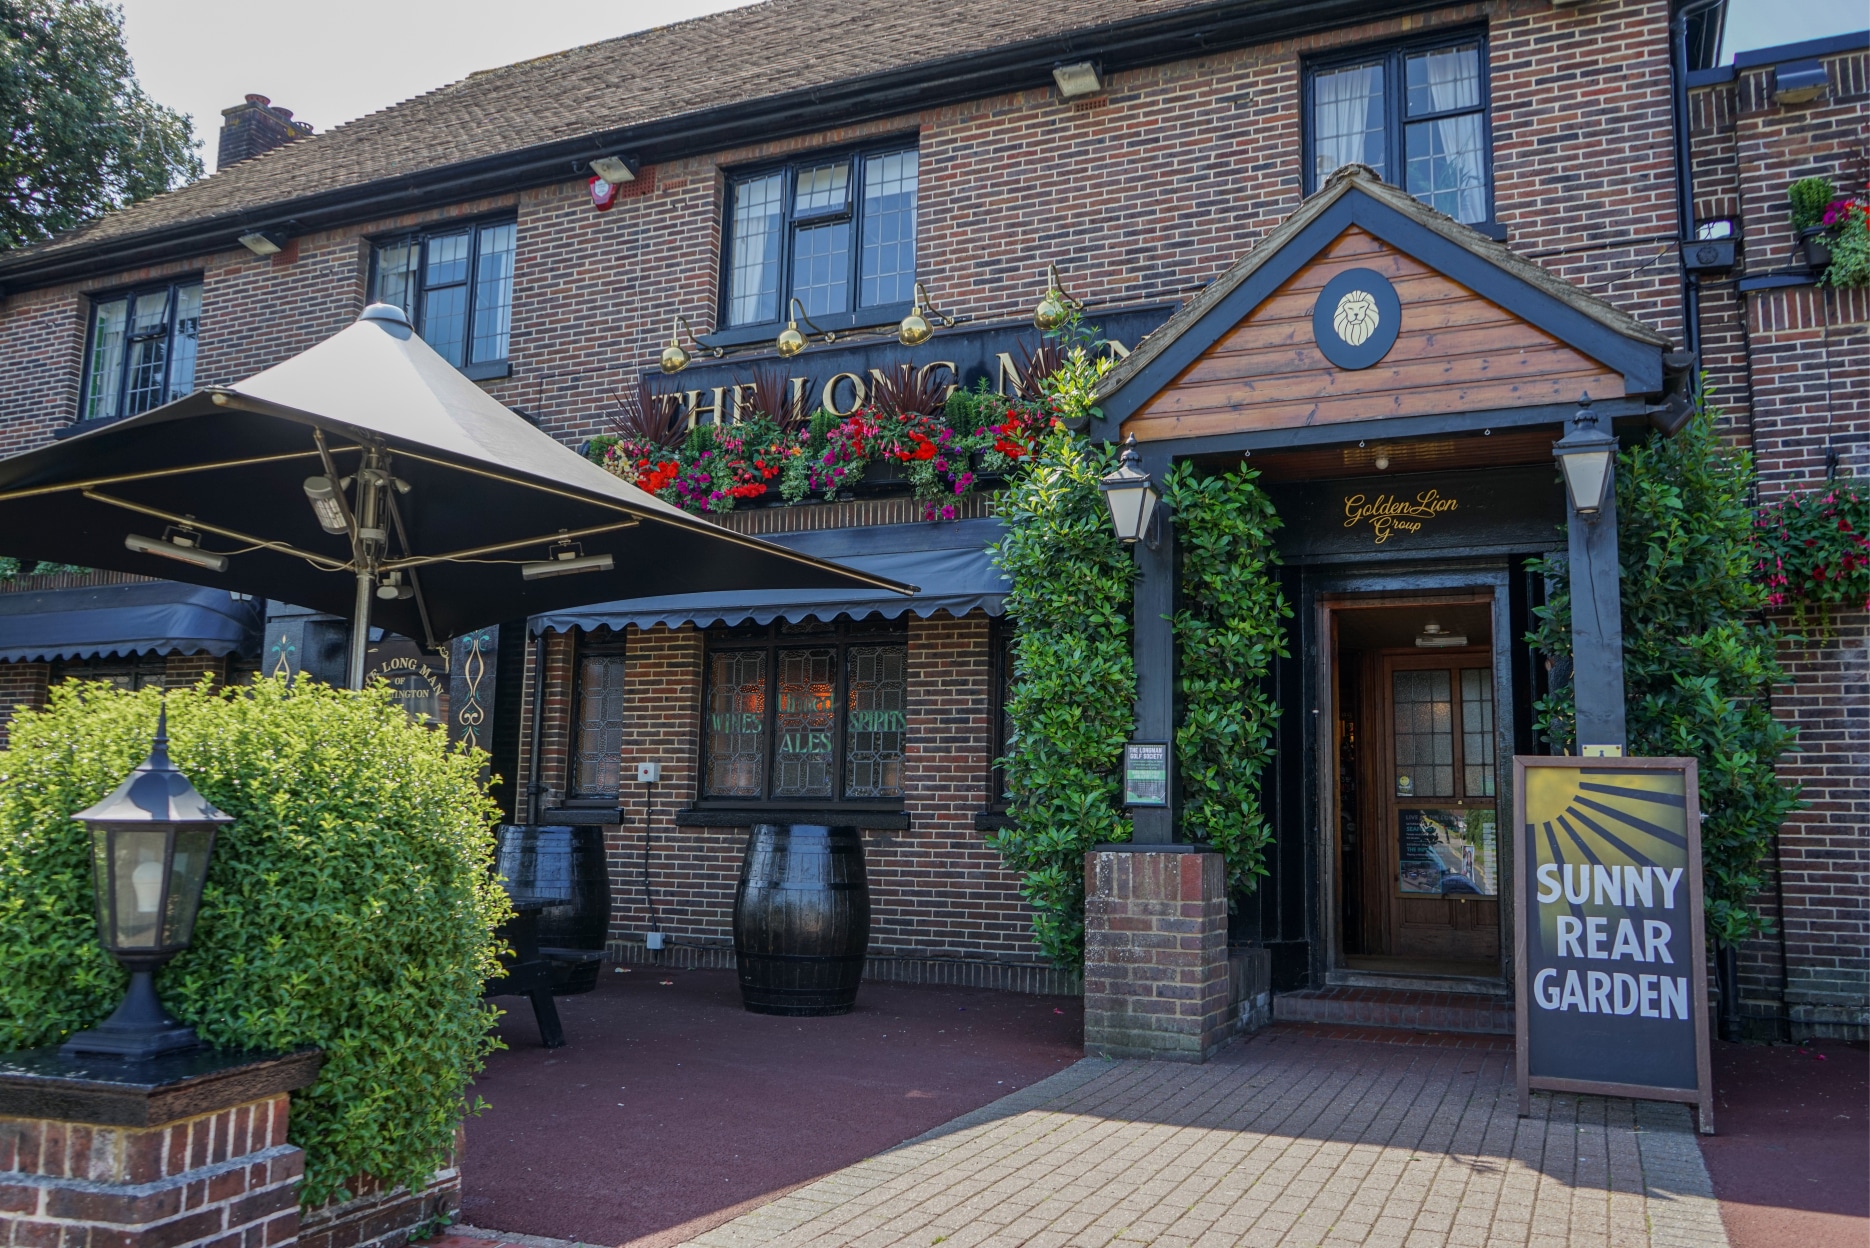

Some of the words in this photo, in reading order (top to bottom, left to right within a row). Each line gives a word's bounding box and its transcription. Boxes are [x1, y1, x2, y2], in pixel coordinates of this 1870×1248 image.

[1344, 494, 1411, 527] Golden
[1410, 489, 1458, 518] Lion
[1375, 517, 1421, 544] Group
[382, 657, 417, 673] LONG
[419, 664, 444, 696] MAN
[394, 677, 406, 685] OF
[712, 713, 762, 733] WINES
[851, 710, 907, 732] SPIRITS
[779, 733, 832, 753] ALES
[1536, 863, 1684, 909] SUNNY
[1557, 915, 1674, 964] REAR
[1533, 968, 1689, 1020] GARDEN
